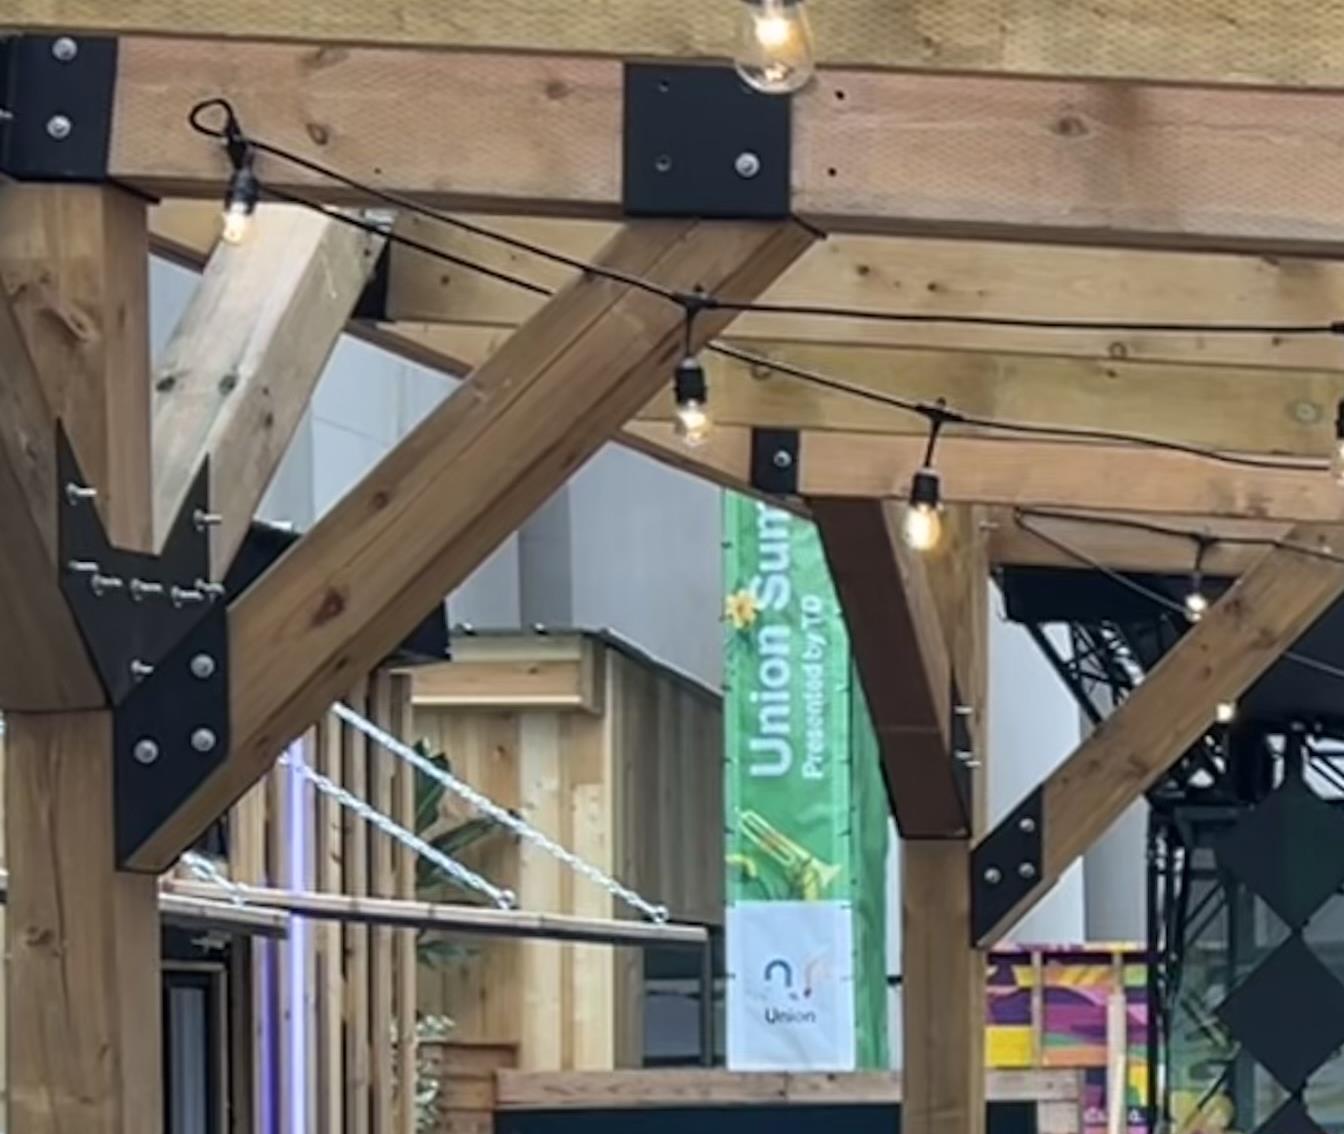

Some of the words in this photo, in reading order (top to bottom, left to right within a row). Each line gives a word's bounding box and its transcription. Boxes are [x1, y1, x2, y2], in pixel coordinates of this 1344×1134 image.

[802, 595, 823, 630] TD
[802, 632, 827, 660] by
[750, 624, 791, 777] Union
[802, 662, 823, 779] Presented
[764, 1008, 816, 1024] Union
